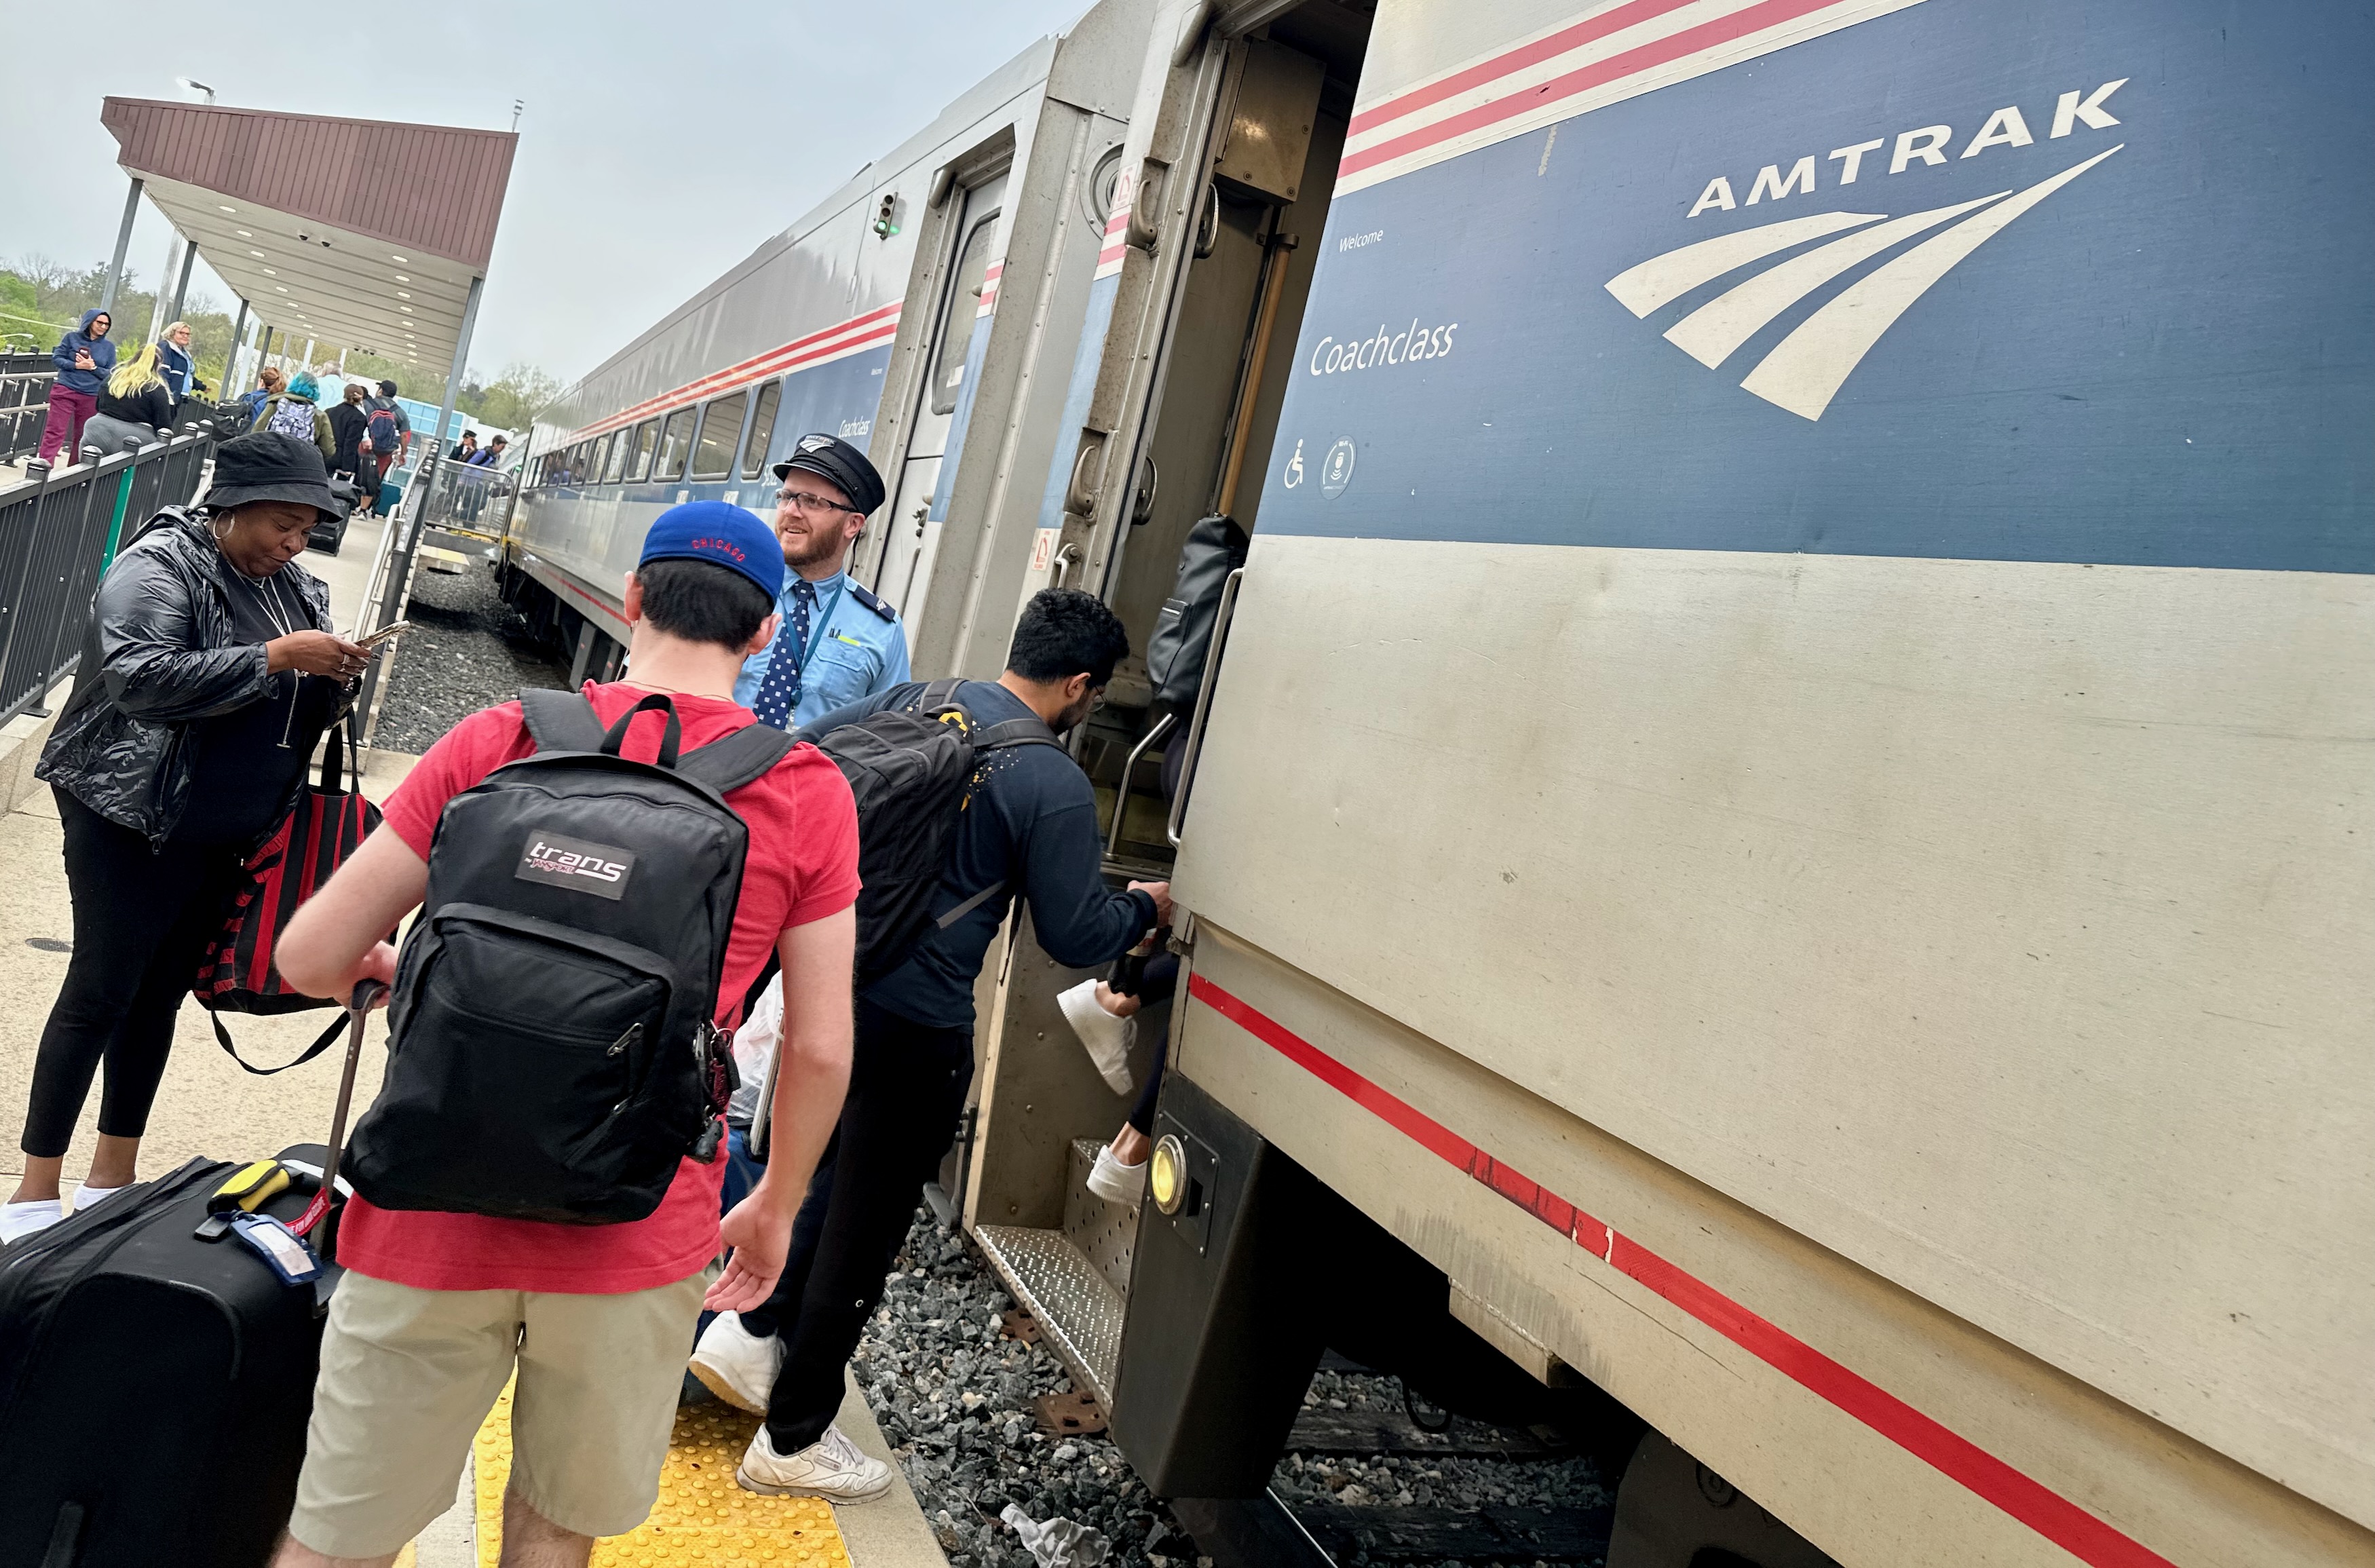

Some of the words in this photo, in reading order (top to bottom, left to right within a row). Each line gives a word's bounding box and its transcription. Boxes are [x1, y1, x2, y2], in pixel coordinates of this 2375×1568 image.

[1686, 78, 2129, 218] AMTRAK
[1339, 229, 1384, 253] Welcome
[1310, 318, 1458, 376] Coachclass
[839, 415, 871, 438] Coachclass
[691, 537, 746, 562] CHICAGO
[529, 841, 626, 882] trans
